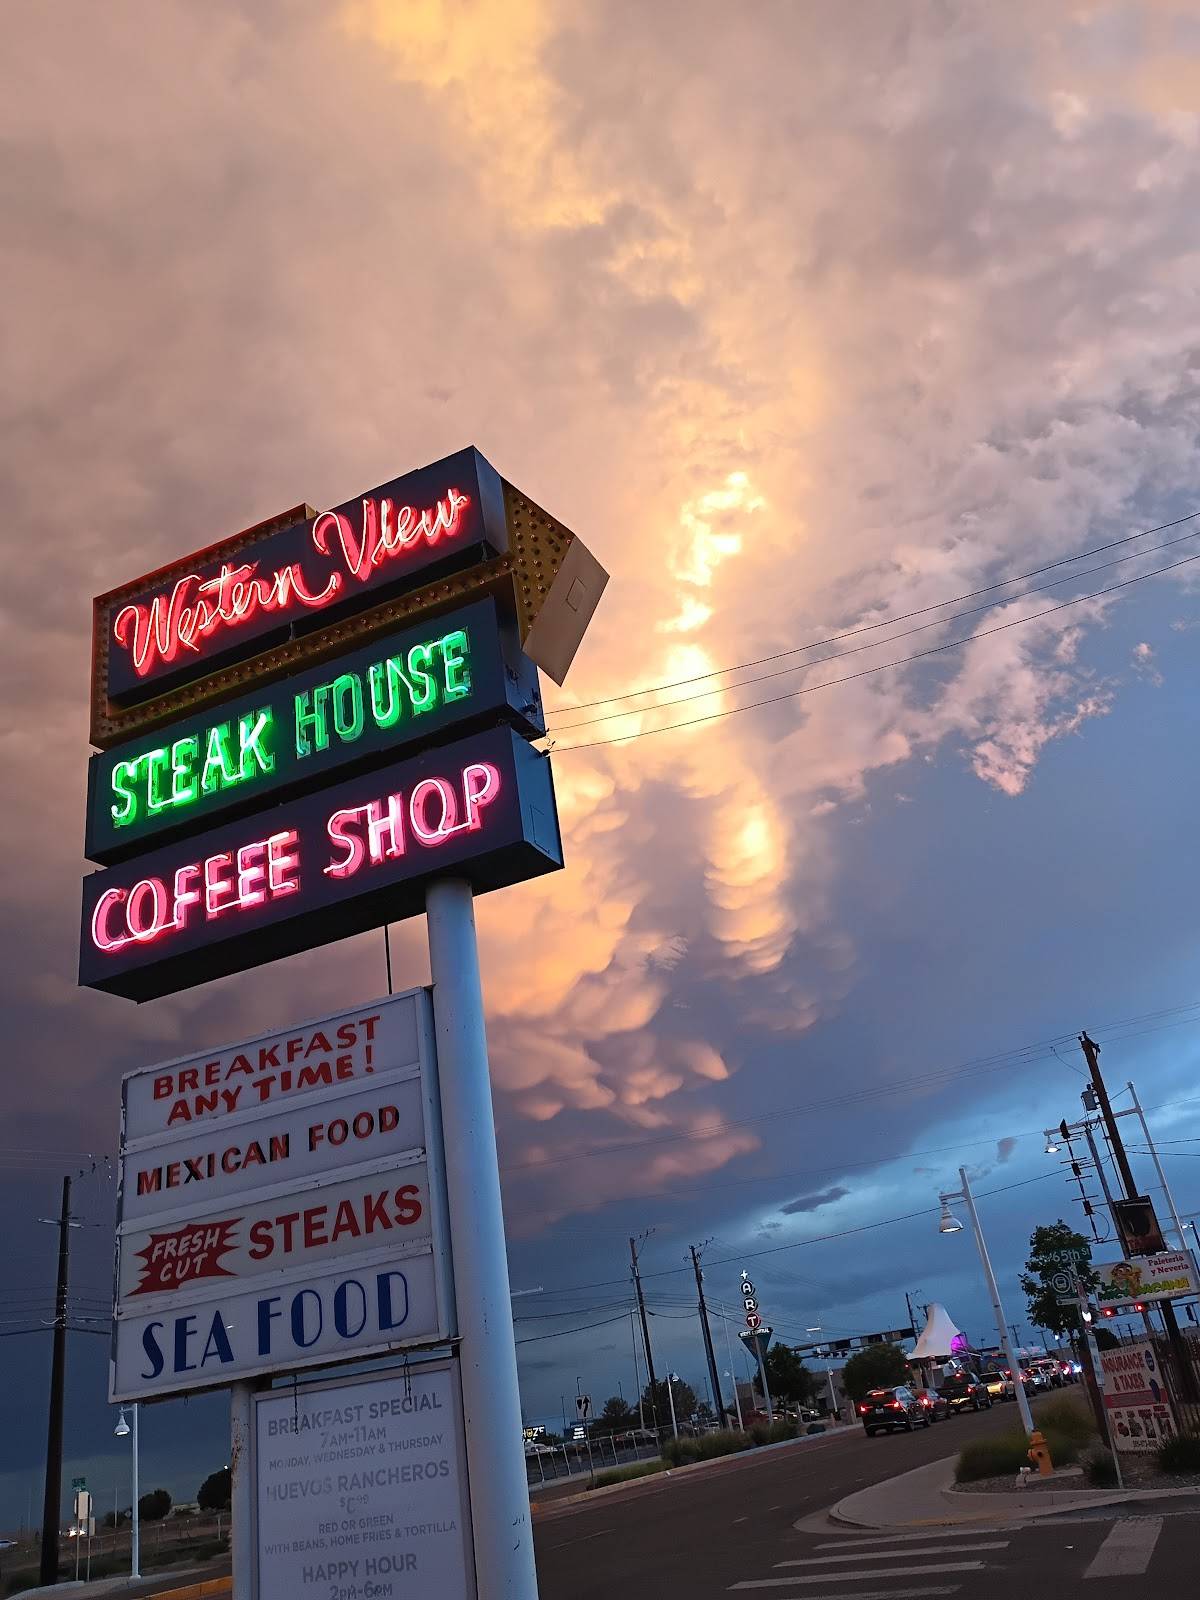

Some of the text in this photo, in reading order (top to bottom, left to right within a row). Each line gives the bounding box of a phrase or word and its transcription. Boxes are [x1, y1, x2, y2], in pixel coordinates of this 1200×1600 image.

[114, 560, 342, 678] Western
[111, 627, 473, 829] STEAK HOUSE
[91, 762, 501, 953] COFFEE SHOP
[153, 1015, 381, 1100] BREAKFAST
[167, 1085, 242, 1126] ANY
[137, 1105, 400, 1196] MEXICAN FOOD
[248, 1184, 423, 1260] STEAKS
[151, 1227, 220, 1263] FRESH
[1052, 1249, 1081, 1262] 65th
[159, 1253, 209, 1282] CUT
[141, 1271, 409, 1380] SEA FOOD
[1118, 1372, 1146, 1390] TAXES
[268, 1392, 443, 1436] BREAKFAST SPECIAL
[388, 1434, 444, 1452] THURSDAY
[337, 1460, 450, 1493] RANCHEROS
[265, 1543, 290, 1555] WITH
[330, 1534, 360, 1547] HOME
[362, 1529, 391, 1543] FRIES
[404, 1520, 457, 1536] TORTILLA
[318, 1514, 395, 1534] RED OR GREEN
[302, 1553, 418, 1584] HAPPY HOUR
